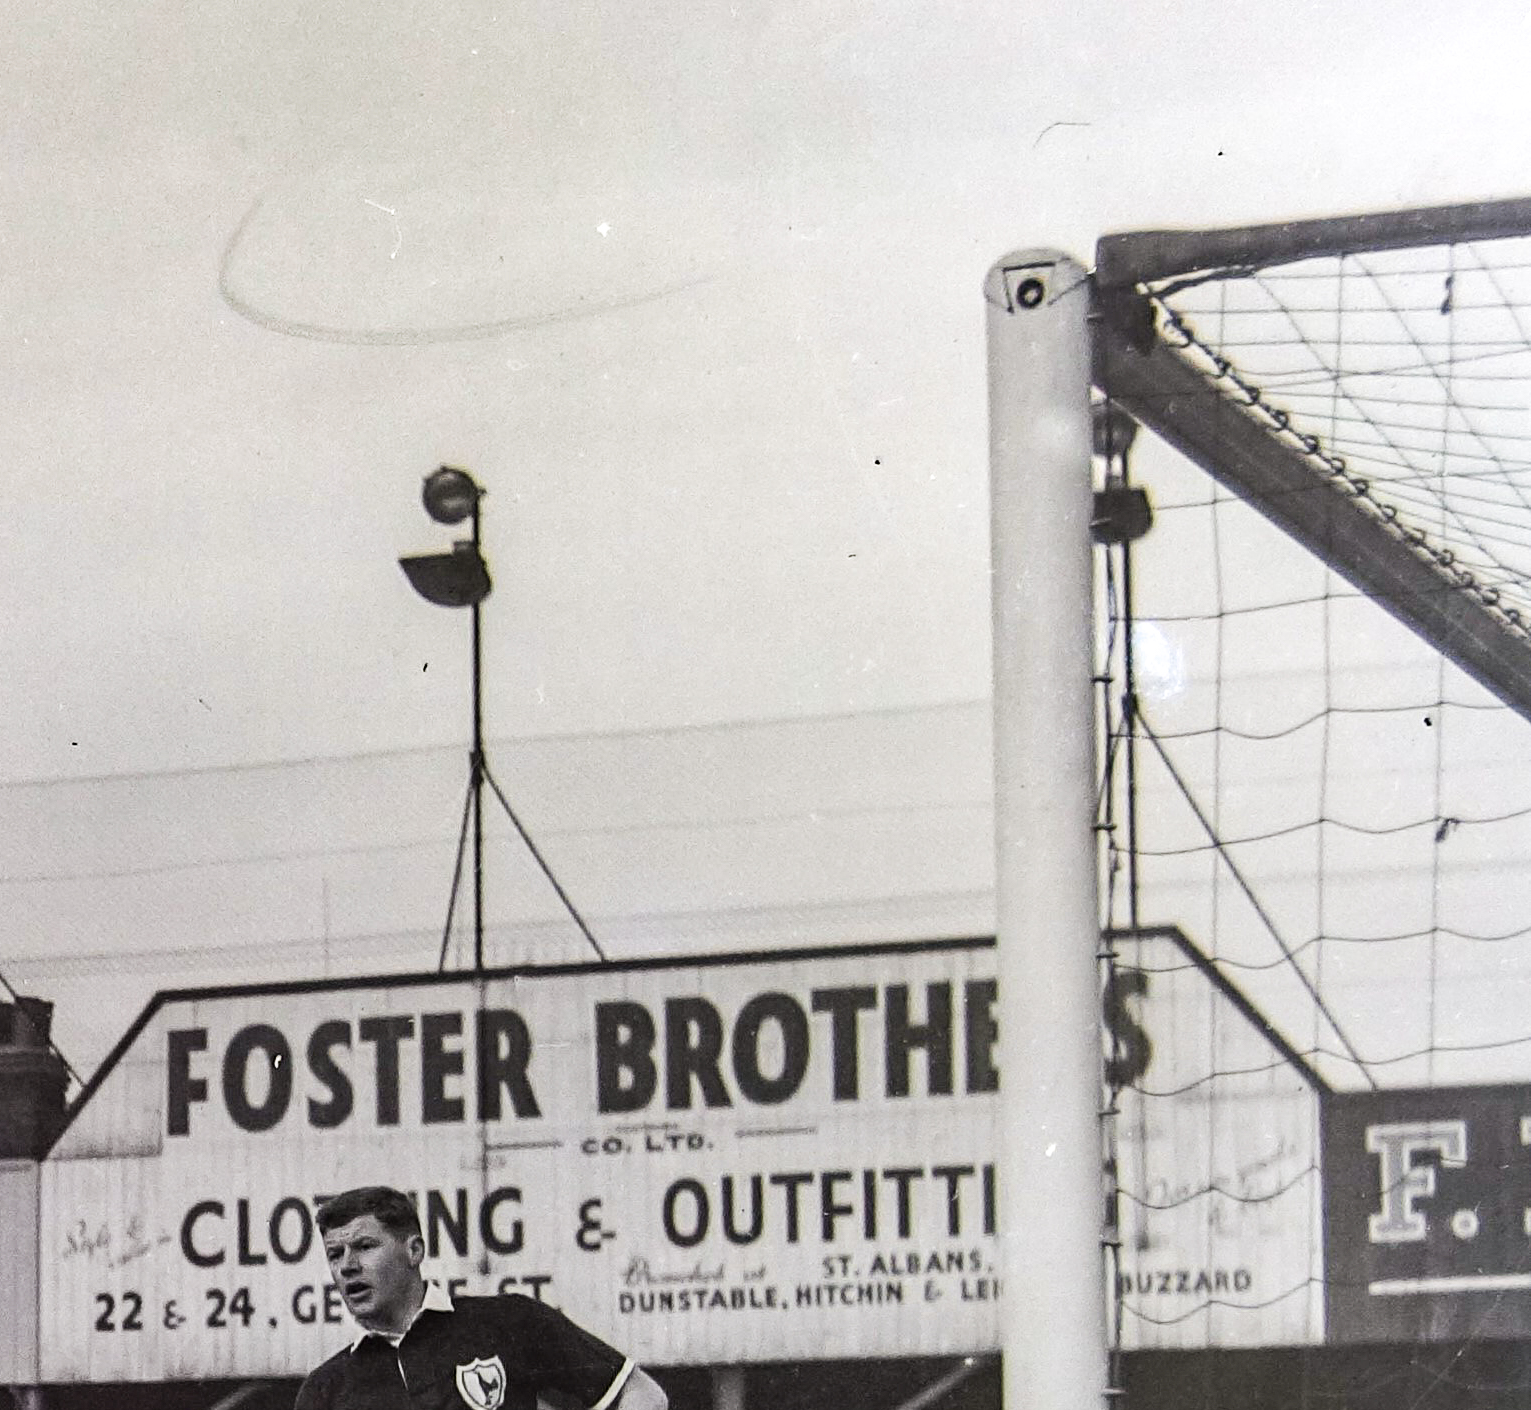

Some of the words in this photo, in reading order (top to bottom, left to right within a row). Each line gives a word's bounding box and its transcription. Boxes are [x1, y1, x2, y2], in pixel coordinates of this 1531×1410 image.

[167, 1008, 542, 1137] FOSTER
[595, 971, 1152, 1114] BROTHES
[581, 1137, 632, 1155] CO.
[646, 1132, 713, 1153] LTD.
[180, 1187, 524, 1268] CLONG
[576, 1199, 618, 1252] &
[663, 1163, 1118, 1248] OUTFITTI
[822, 1253, 859, 1278] ST.
[796, 1279, 902, 1308] HITCHIN
[95, 1291, 143, 1332] 22
[163, 1299, 186, 1330] &
